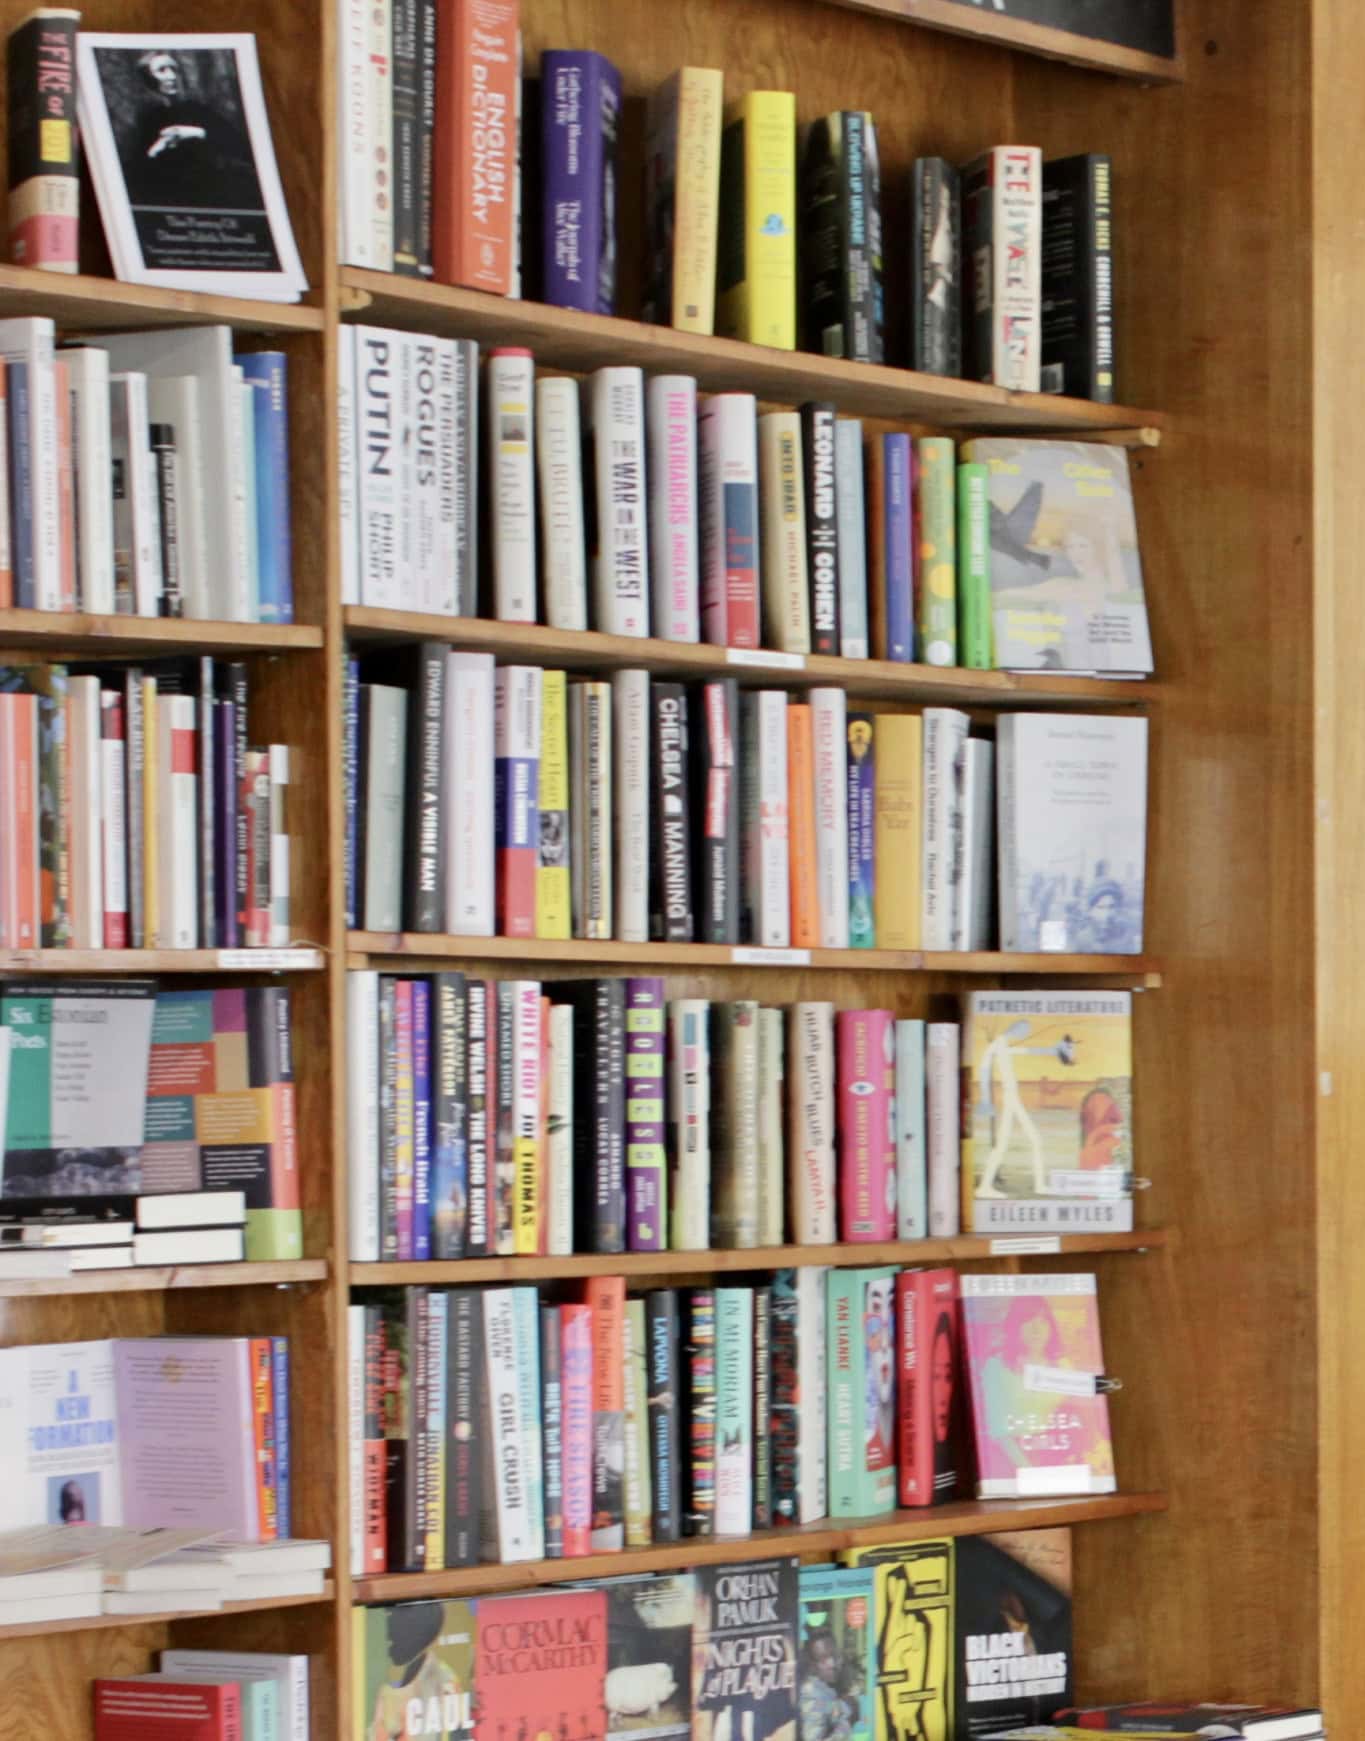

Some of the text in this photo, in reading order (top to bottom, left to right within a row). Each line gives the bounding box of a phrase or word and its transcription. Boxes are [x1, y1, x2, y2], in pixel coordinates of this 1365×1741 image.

[38, 46, 72, 94] FIRE
[471, 64, 505, 225] ENGLISH DICTIONARY
[364, 339, 392, 477] PUTIN
[415, 344, 436, 488] ROGUES
[440, 350, 454, 525] THE PERSUADERS
[666, 392, 689, 578] THE PATRIARCHS ANGELA
[368, 511, 394, 581] PHILIP SHORT
[613, 461, 641, 602] WAR WEST
[814, 410, 837, 631] LEONARD COHEN
[421, 660, 442, 892] EDWARD ENNINFUL A VISIBLE MAN
[818, 710, 836, 833] RED MEMORY
[662, 698, 687, 919] CHELSEA MANNING
[713, 846, 727, 879] Junaid
[804, 1010, 822, 1052] HIJAB
[521, 989, 537, 1227] WHITE RIOT THOMAS
[806, 1054, 824, 1102] BUTCH
[470, 987, 486, 1245] IRVINE WELSH THE LONG KNIVES
[806, 1103, 823, 1147] BLUES
[416, 1101, 429, 1205] French Braid
[805, 1150, 824, 1197] LAMYA
[990, 1203, 1115, 1223] EILEEN MYLES
[837, 1296, 851, 1322] YAN
[904, 1290, 918, 1370] Constance Wu
[653, 1317, 668, 1384] LAPVONA
[837, 1326, 851, 1372] LIANKE
[499, 1393, 523, 1510] GIRL CRUSH
[715, 1567, 780, 1601] ORHAN
[481, 1614, 601, 1651] CORMAC
[483, 1645, 600, 1677] McCARTHY
[707, 1635, 787, 1670] NIGHTS
[721, 1662, 797, 1698] PLAGUE
